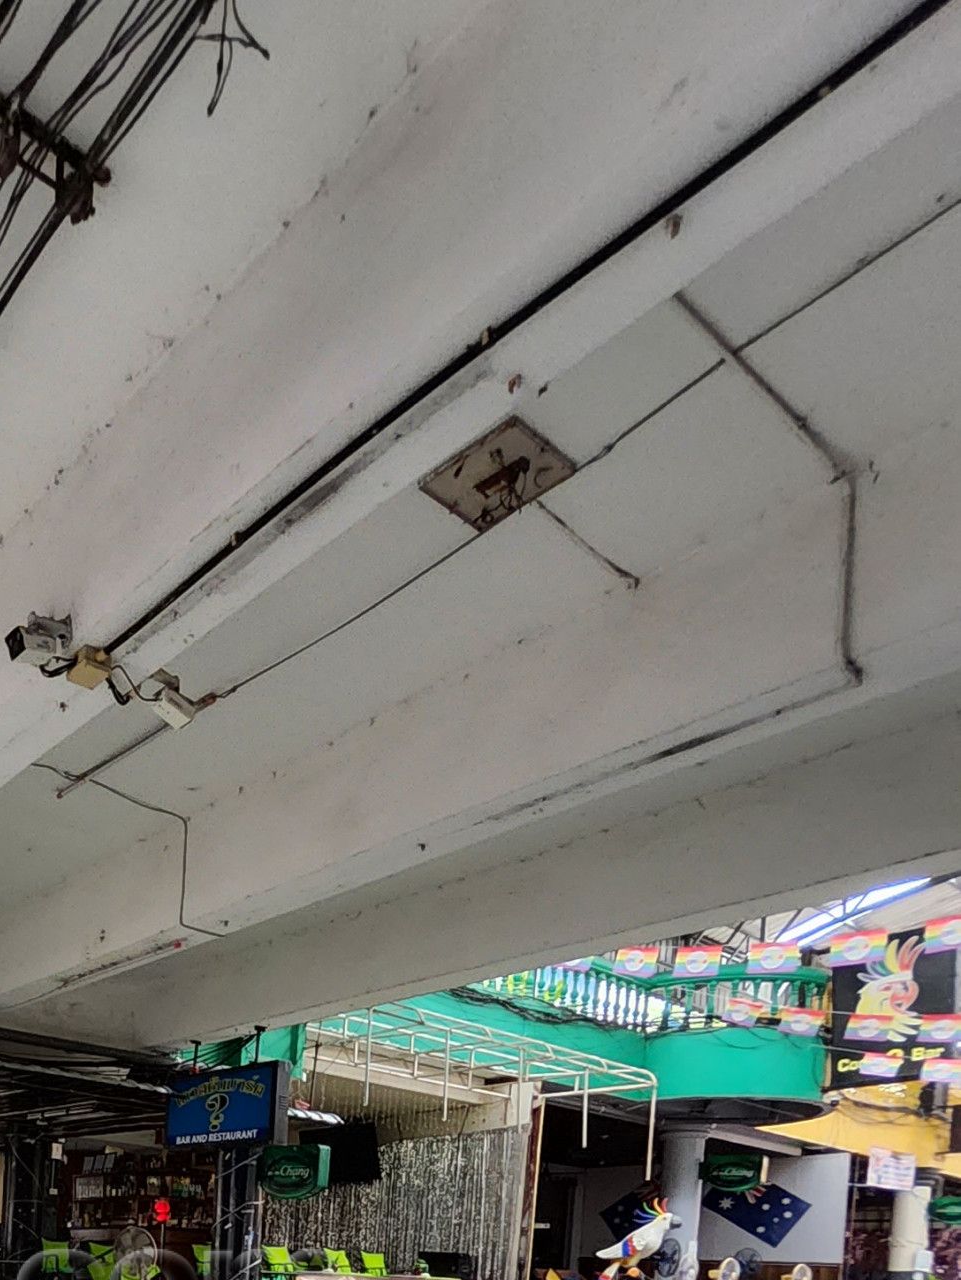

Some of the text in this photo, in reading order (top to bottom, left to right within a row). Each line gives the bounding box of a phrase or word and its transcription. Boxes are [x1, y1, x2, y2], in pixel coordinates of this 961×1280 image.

[175, 1129, 258, 1145] BAR AND RESTAURANT
[280, 1165, 310, 1179] Chang
